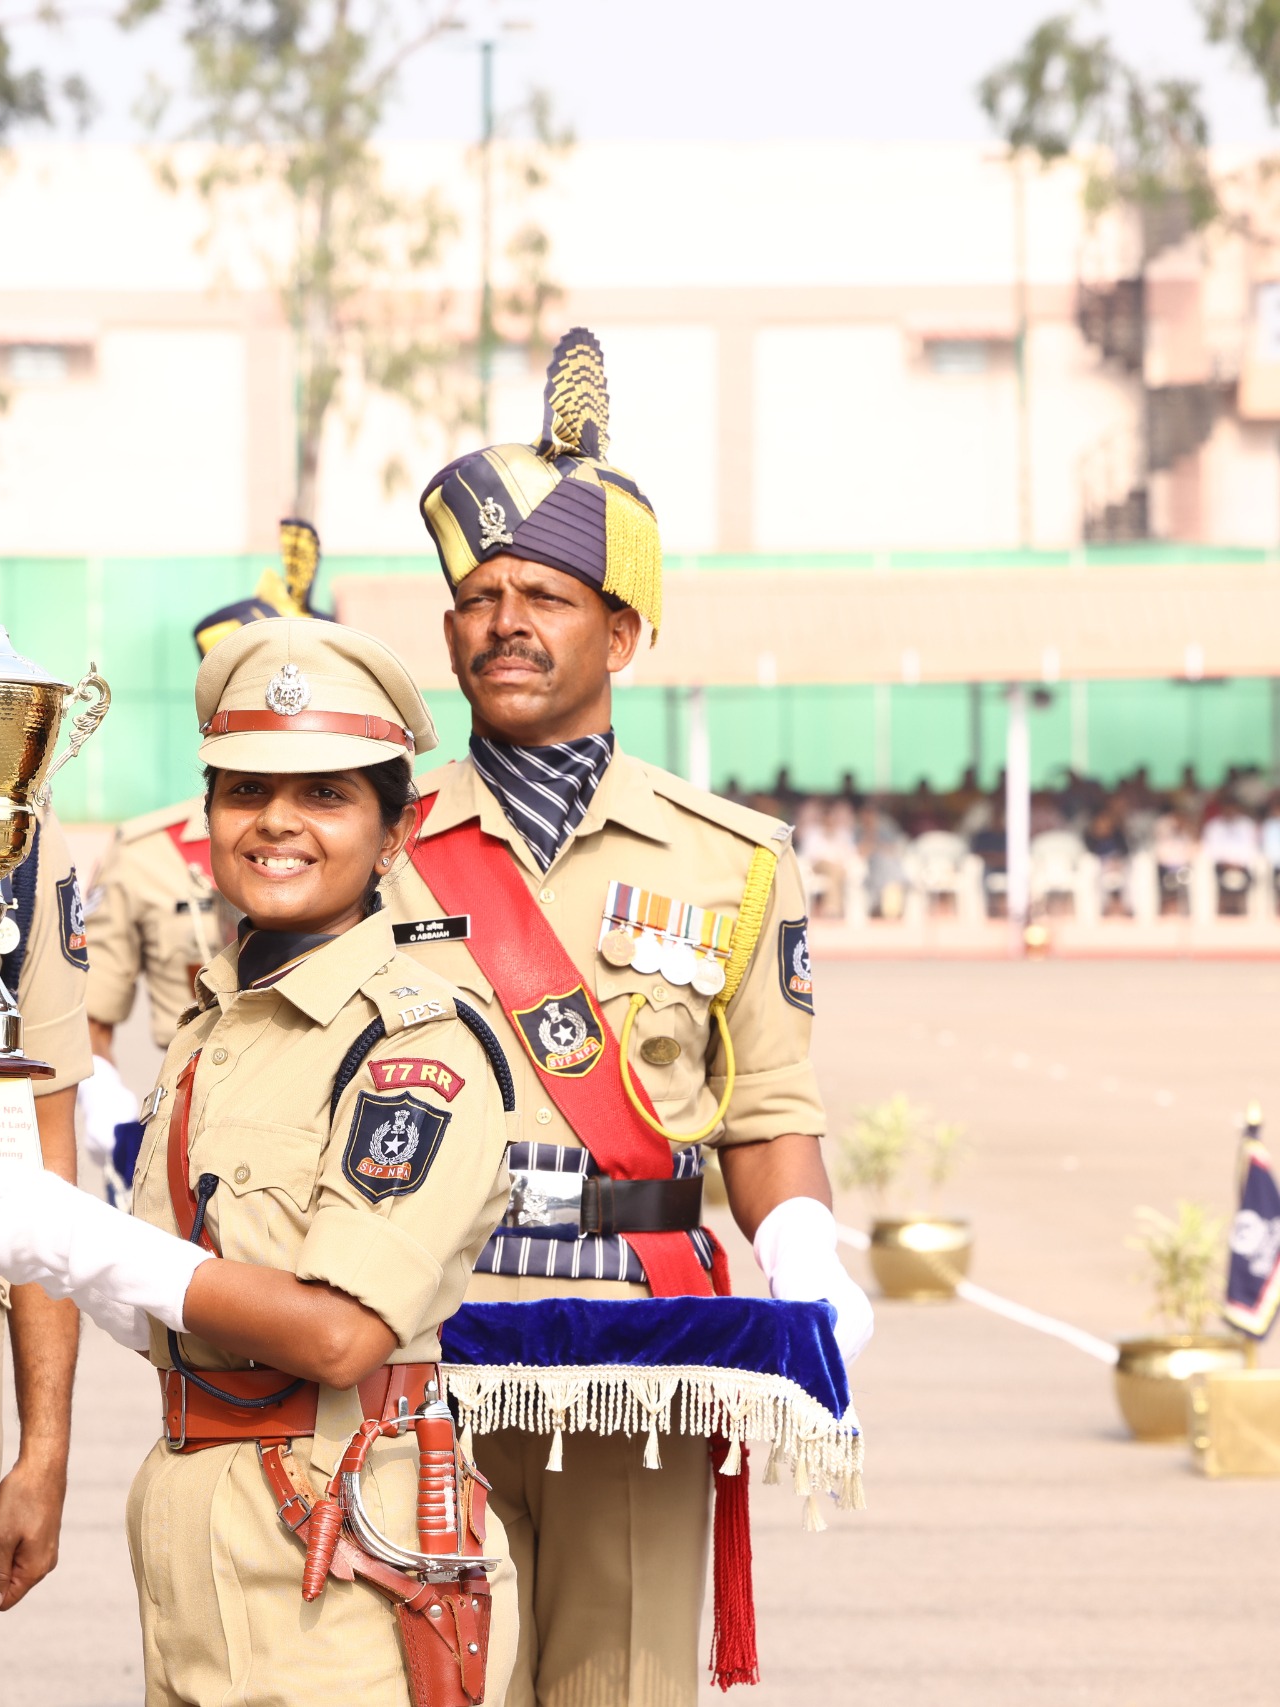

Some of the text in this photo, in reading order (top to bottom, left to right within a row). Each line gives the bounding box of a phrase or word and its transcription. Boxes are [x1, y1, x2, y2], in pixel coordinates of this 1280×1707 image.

[417, 930, 450, 941] ABBAIAH
[791, 980, 811, 991] SVP
[550, 1042, 599, 1067] SVP NPA
[381, 1063, 453, 1092] 77 RR
[3, 1106, 24, 1114] NPA
[8, 1121, 32, 1131] Lady
[359, 1162, 409, 1178] SVP NPA
